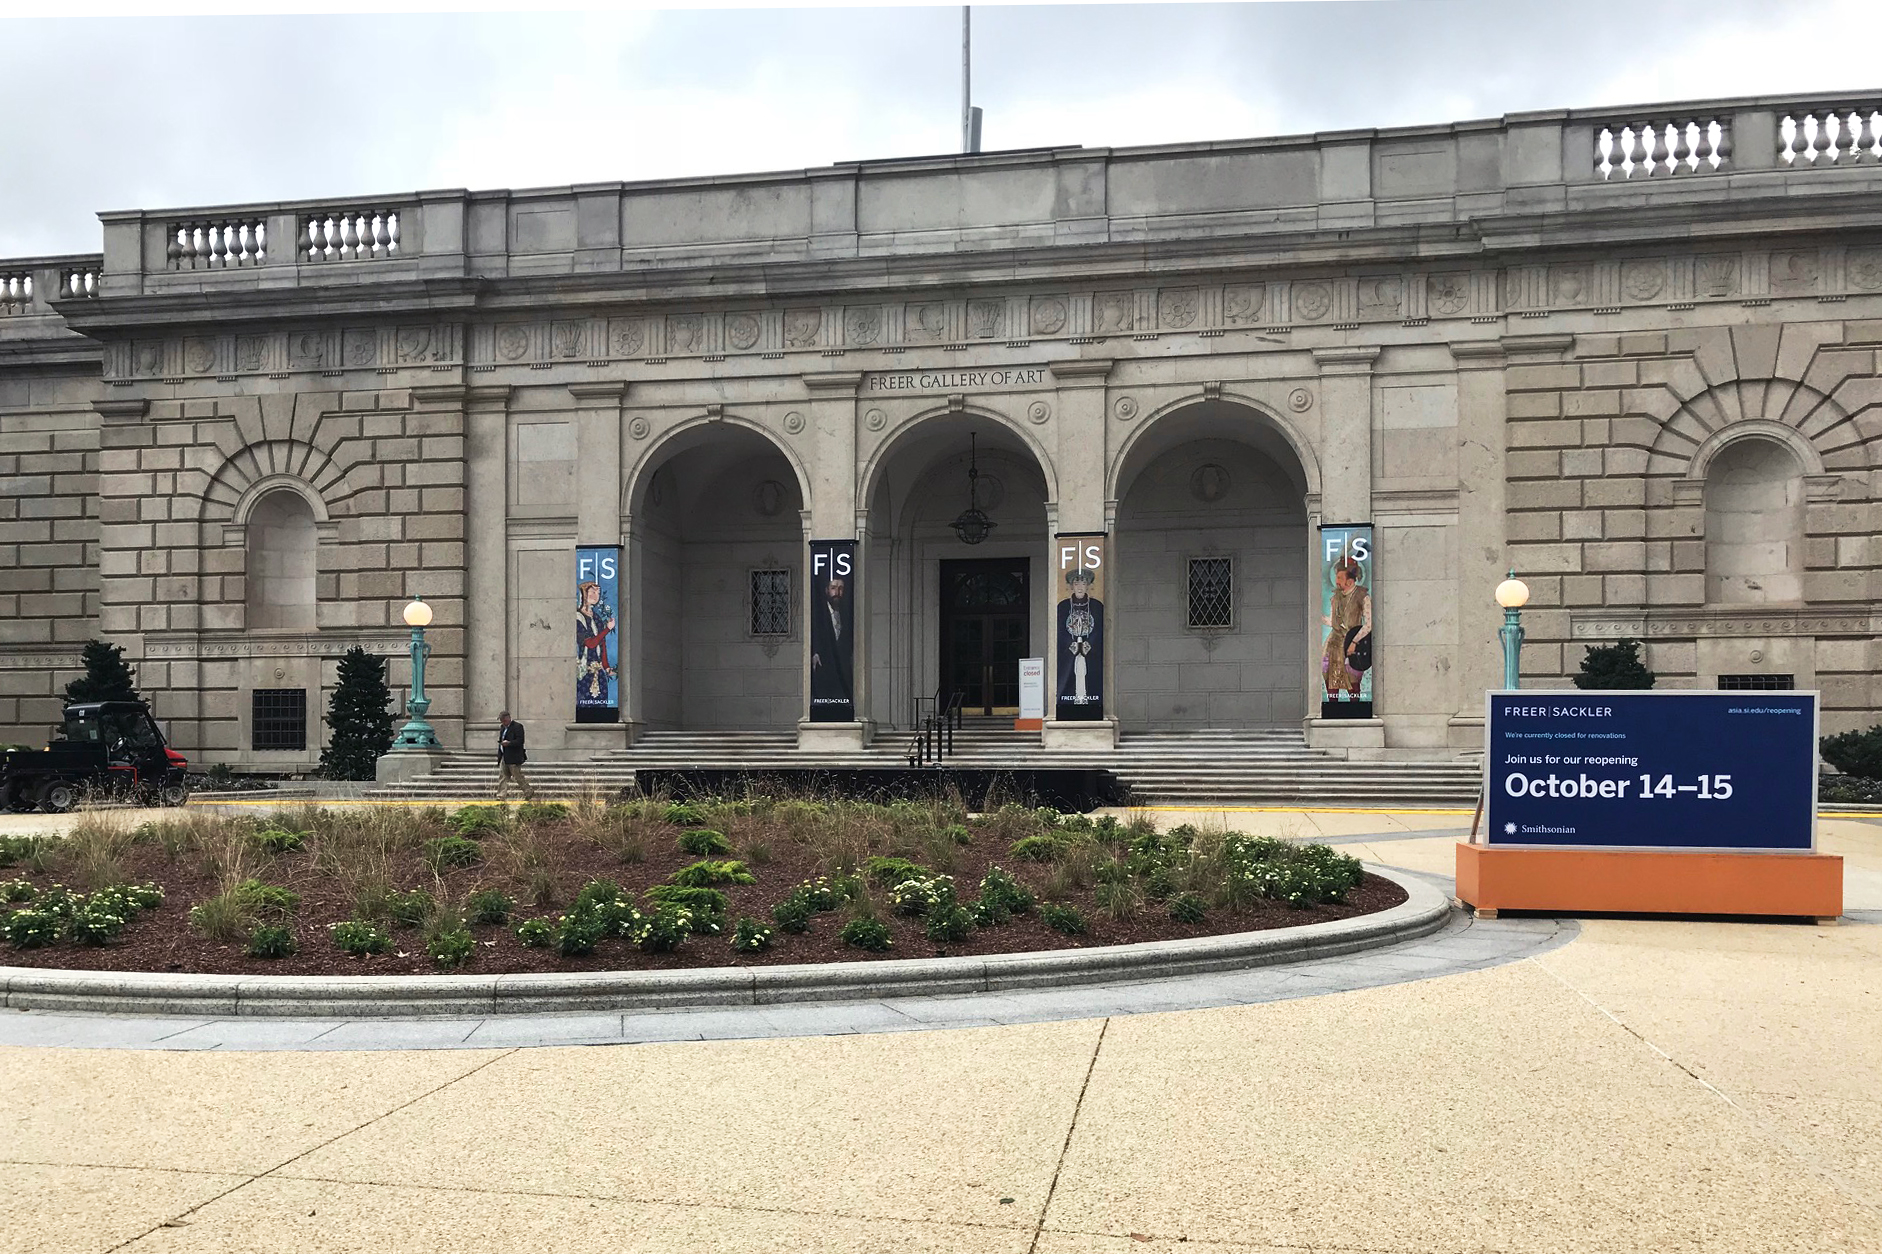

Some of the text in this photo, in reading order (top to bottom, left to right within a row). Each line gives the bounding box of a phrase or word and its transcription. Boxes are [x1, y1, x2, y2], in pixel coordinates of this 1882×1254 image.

[870, 370, 1045, 390] FREER GALLERY OF ART
[1504, 706, 1612, 717] FREER SACKLER
[1727, 706, 1802, 715] asia.si.edu/reopening
[1505, 731, 1523, 739] We're
[1524, 732, 1553, 740] currently
[1504, 754, 1639, 767] Join us for our reopening
[1504, 772, 1631, 799] October
[1521, 824, 1576, 834] Smithsonian
